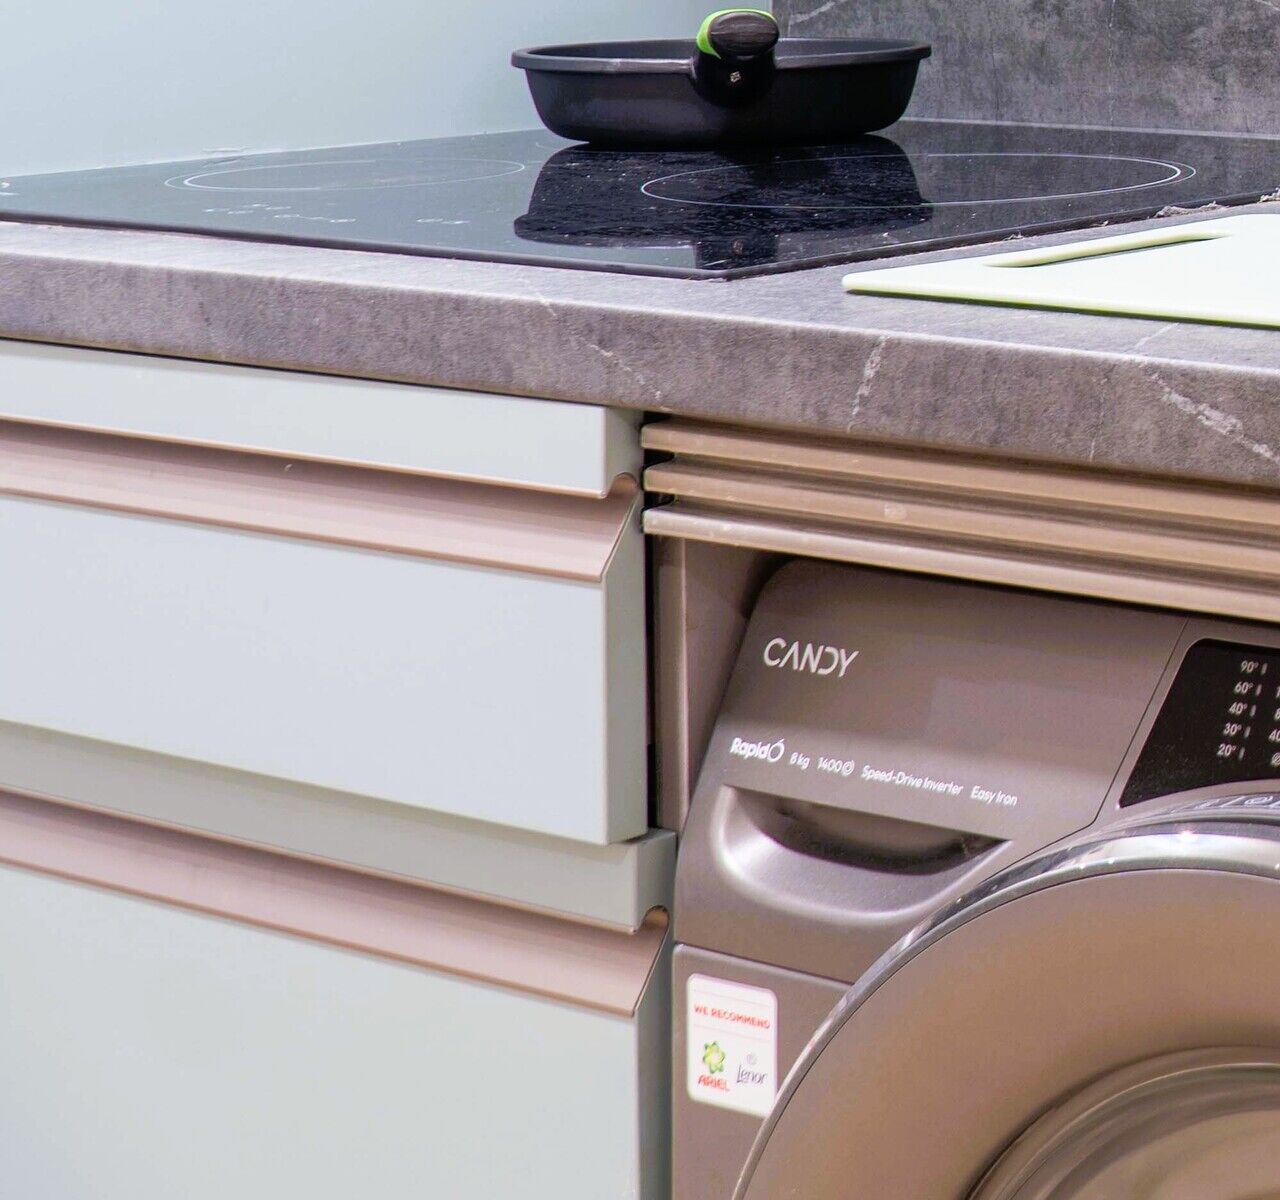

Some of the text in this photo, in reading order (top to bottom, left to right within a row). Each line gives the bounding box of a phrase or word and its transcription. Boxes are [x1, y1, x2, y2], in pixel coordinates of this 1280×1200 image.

[763, 637, 859, 677] CANDY
[970, 785, 996, 804] Easy
[995, 790, 1019, 807] Iron
[694, 1004, 709, 1016] WE
